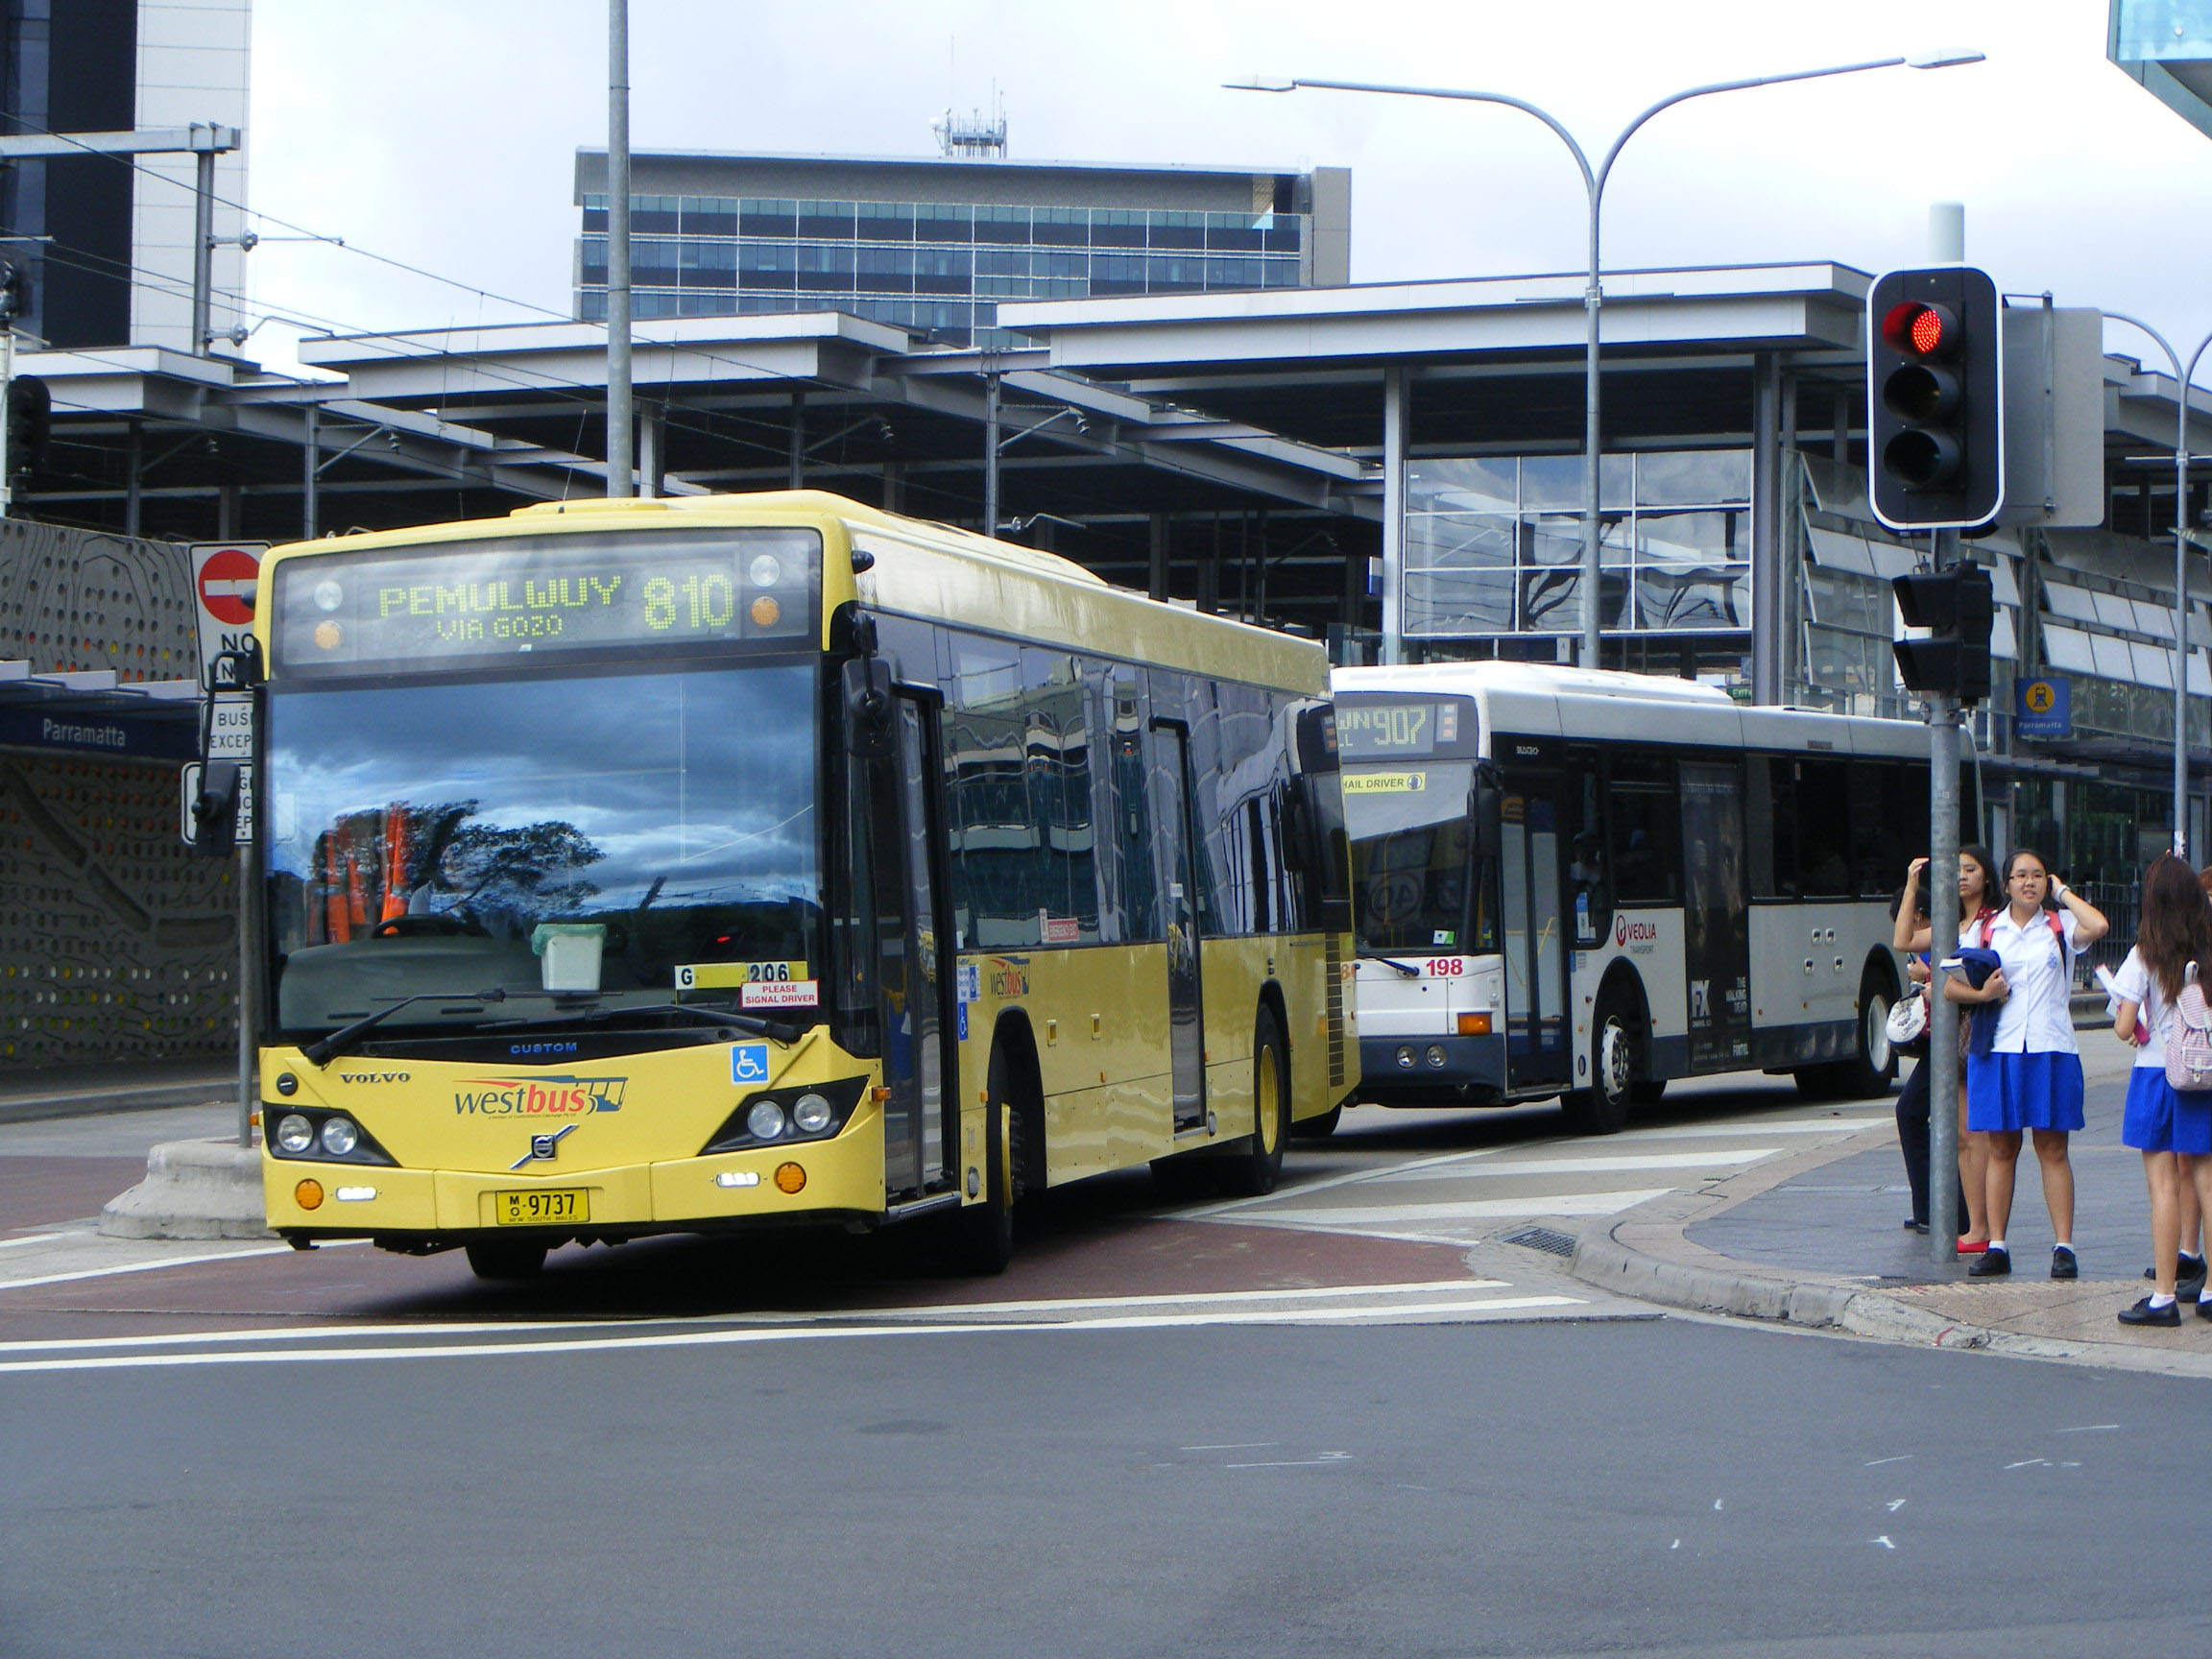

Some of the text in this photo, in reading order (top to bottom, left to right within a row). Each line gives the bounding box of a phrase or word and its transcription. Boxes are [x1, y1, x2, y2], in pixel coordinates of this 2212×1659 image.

[379, 573, 733, 630] PEMULWUY 810
[437, 613, 563, 640] VIA GOZO
[221, 633, 254, 654] NO
[218, 712, 253, 726] BUS
[1373, 707, 1427, 746] 907
[2018, 721, 2062, 730] Parramatta
[42, 718, 127, 748] Parramatta
[1366, 779, 1405, 788] DRIVER
[1627, 923, 1657, 940] VEOLIA
[681, 963, 788, 986] G 206
[1426, 958, 1463, 976] 198
[762, 984, 798, 994] PLEASE
[990, 965, 1022, 996] westbus
[745, 994, 815, 1004] SIGNAL DRIVER
[1691, 979, 1711, 1018] FX
[509, 1042, 578, 1055] CUSTOM
[340, 1071, 411, 1084] VOLVO
[453, 1084, 586, 1115] westbus
[509, 1193, 575, 1216] M 9737
